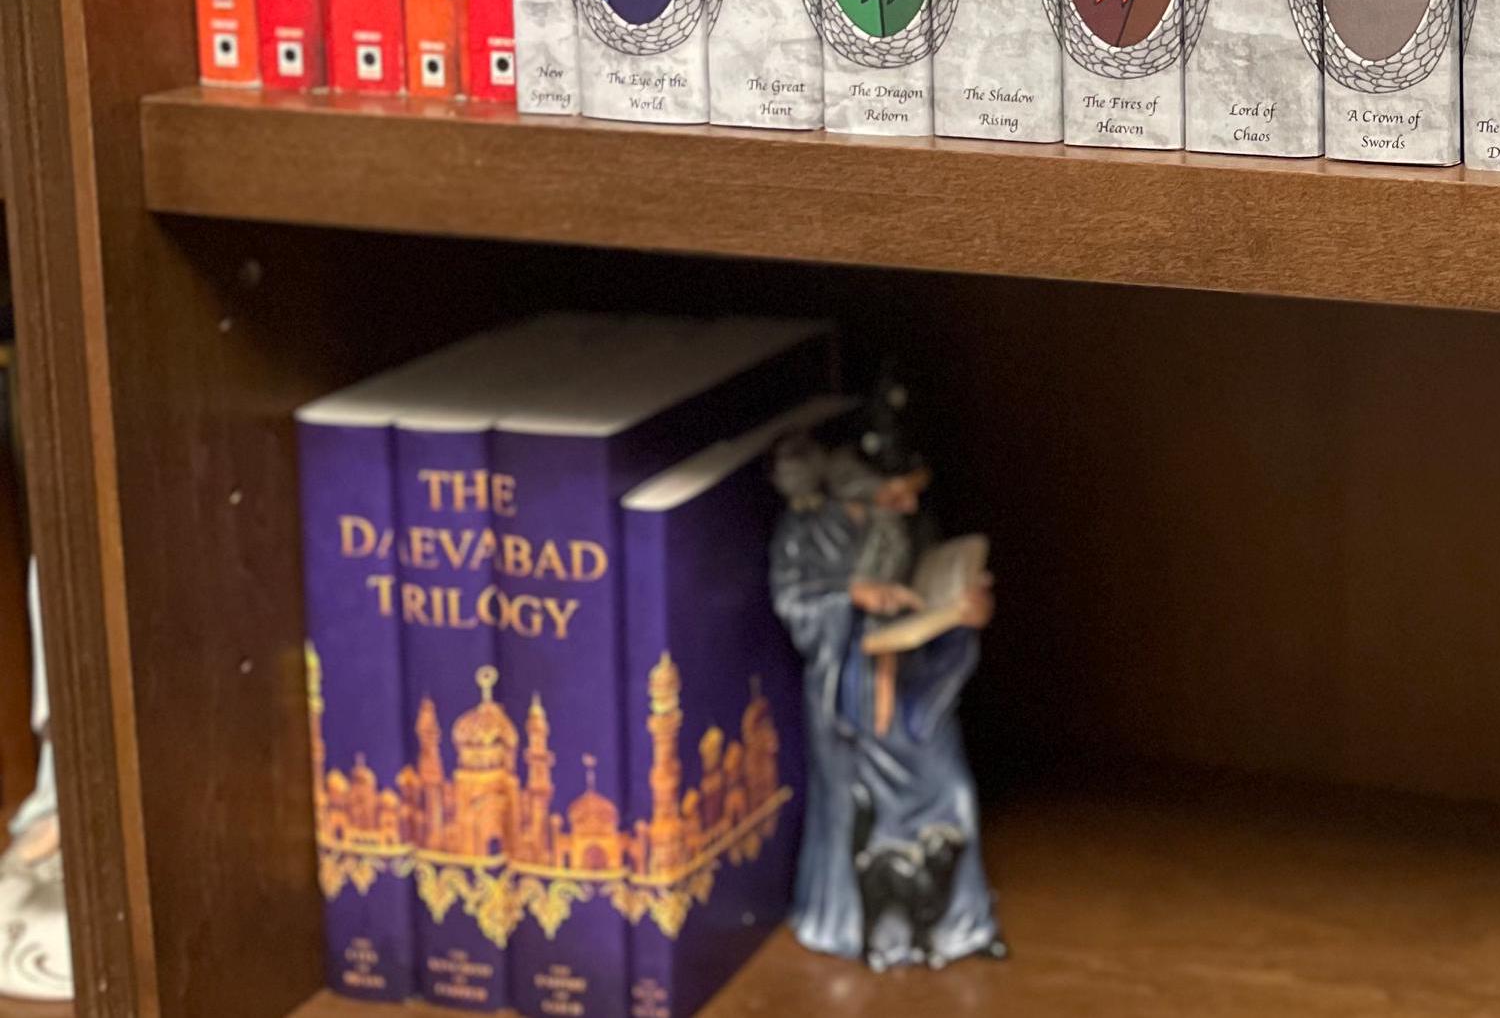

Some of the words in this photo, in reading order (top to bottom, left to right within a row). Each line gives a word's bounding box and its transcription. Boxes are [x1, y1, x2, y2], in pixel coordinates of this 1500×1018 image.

[536, 65, 564, 80] New
[606, 71, 627, 87] The
[628, 74, 651, 91] Eye
[654, 72, 669, 90] of
[668, 73, 687, 88] the
[746, 78, 768, 93] The
[771, 79, 805, 95] Great
[849, 83, 872, 98] The
[874, 85, 923, 103] Dragon
[530, 90, 571, 108] Spring
[629, 96, 664, 111] World
[963, 87, 986, 103] The
[989, 87, 1034, 104] Shadow
[760, 102, 793, 118] Hunt
[1082, 95, 1107, 110] The
[1110, 96, 1142, 112] Fires
[1145, 98, 1159, 116] of
[1229, 102, 1260, 118] Lord
[1262, 103, 1277, 122] of
[864, 108, 908, 123] Reborn
[978, 114, 1020, 133] Rising
[1347, 109, 1358, 123] A
[1361, 110, 1403, 126] Crown
[1406, 110, 1422, 130] of
[1096, 120, 1144, 136] Heaven
[1233, 127, 1271, 143] Chaos
[1476, 119, 1500, 135] The
[1361, 134, 1406, 151] Swords
[417, 468, 518, 517] THE
[338, 514, 608, 582] DAEVABAD
[366, 574, 580, 640] TRILOGY
